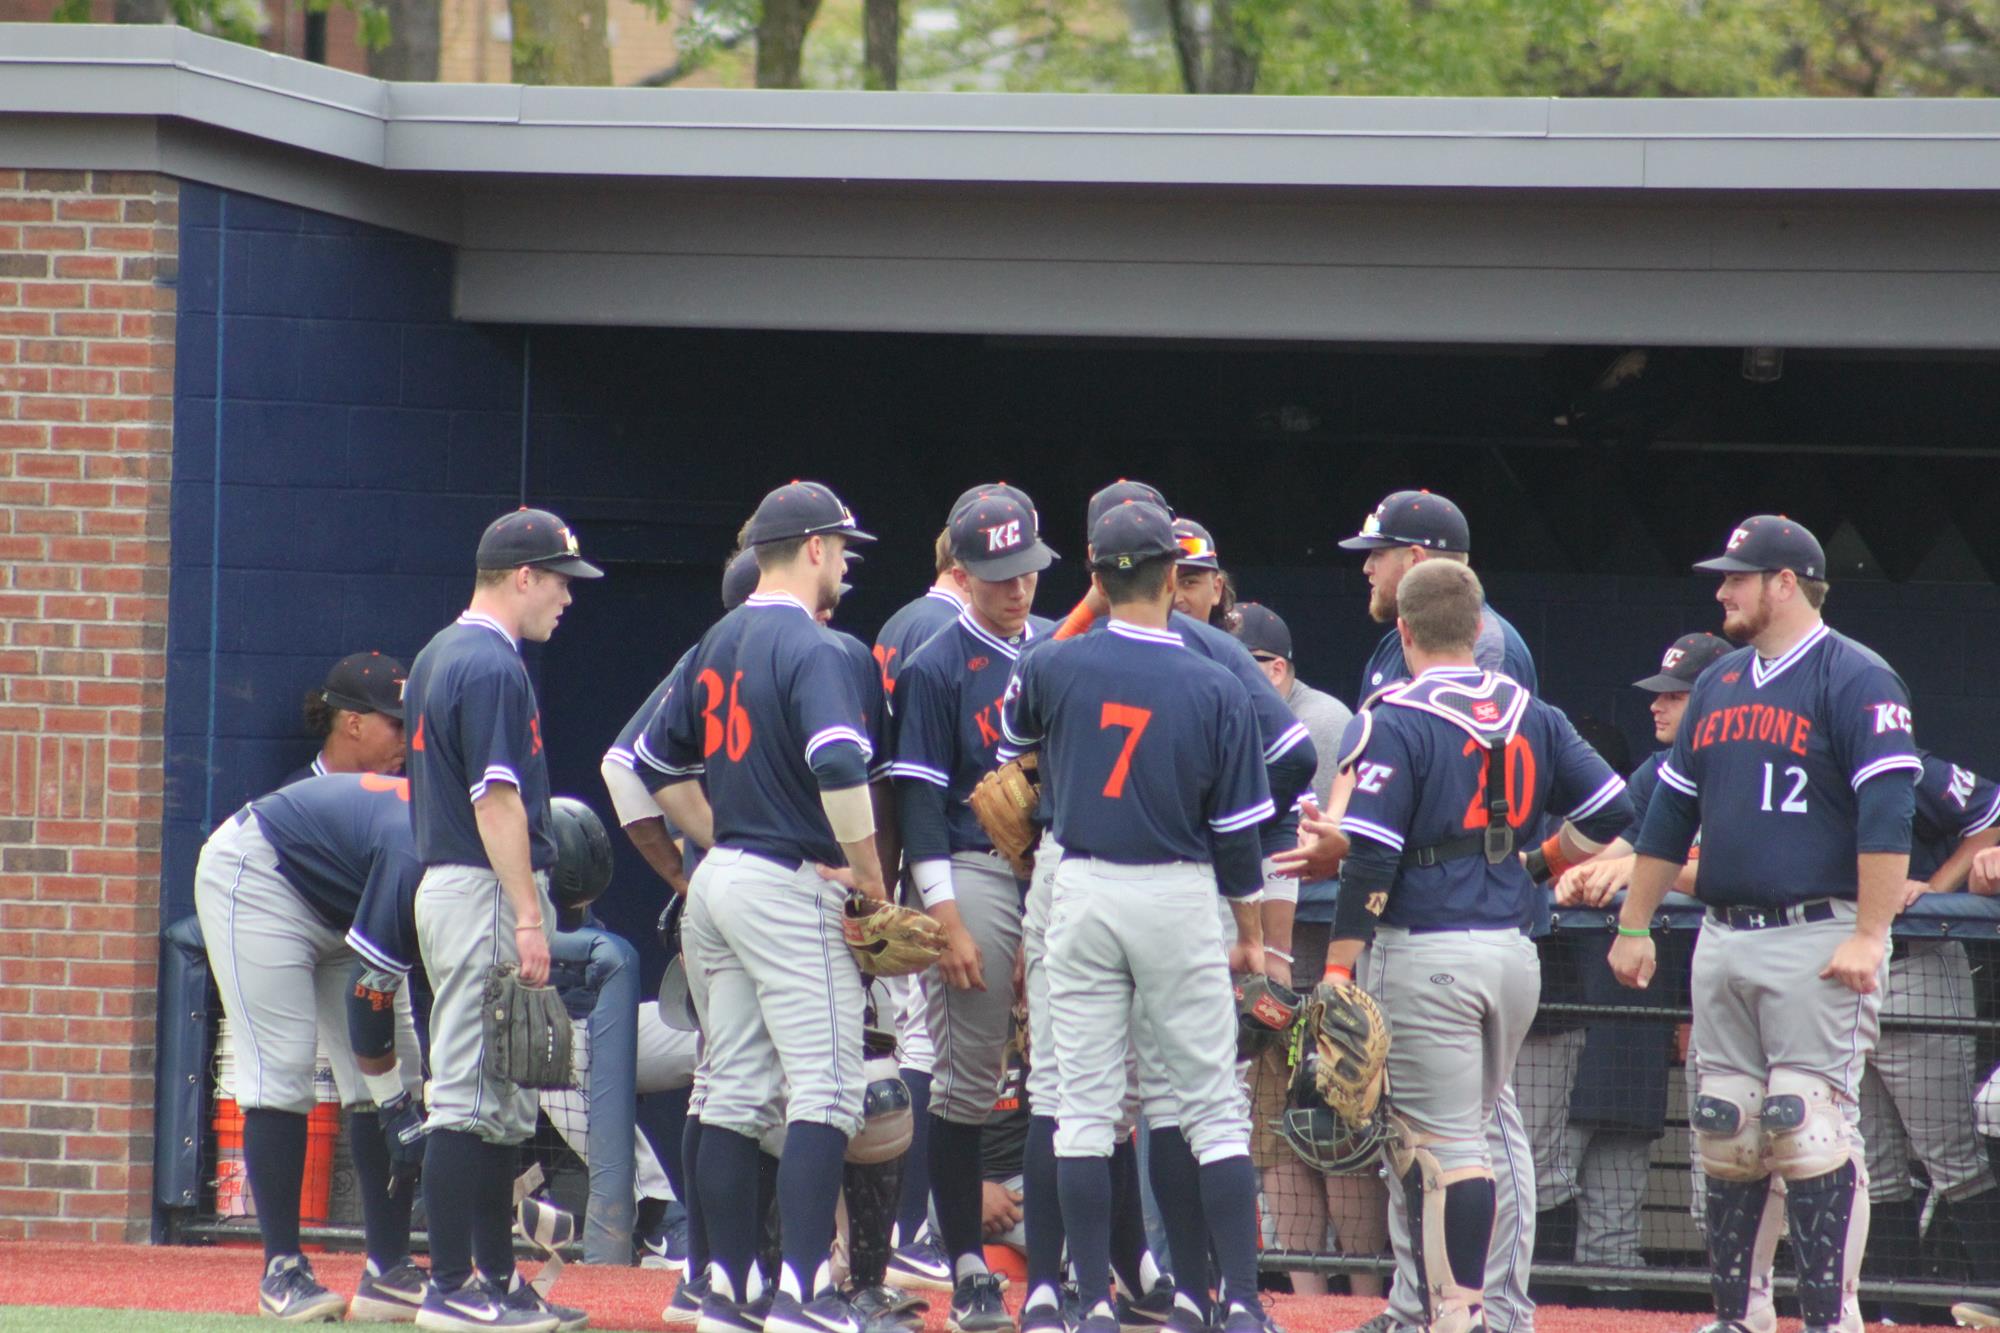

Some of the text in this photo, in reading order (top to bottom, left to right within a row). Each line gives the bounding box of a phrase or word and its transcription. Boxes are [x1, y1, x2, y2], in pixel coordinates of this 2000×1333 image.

[987, 519, 1021, 551] KC
[697, 668, 752, 762] 36
[1100, 702, 1152, 799] 7
[1873, 703, 1912, 734] KC
[1462, 734, 1536, 829] 20
[1761, 762, 1808, 813] 12
